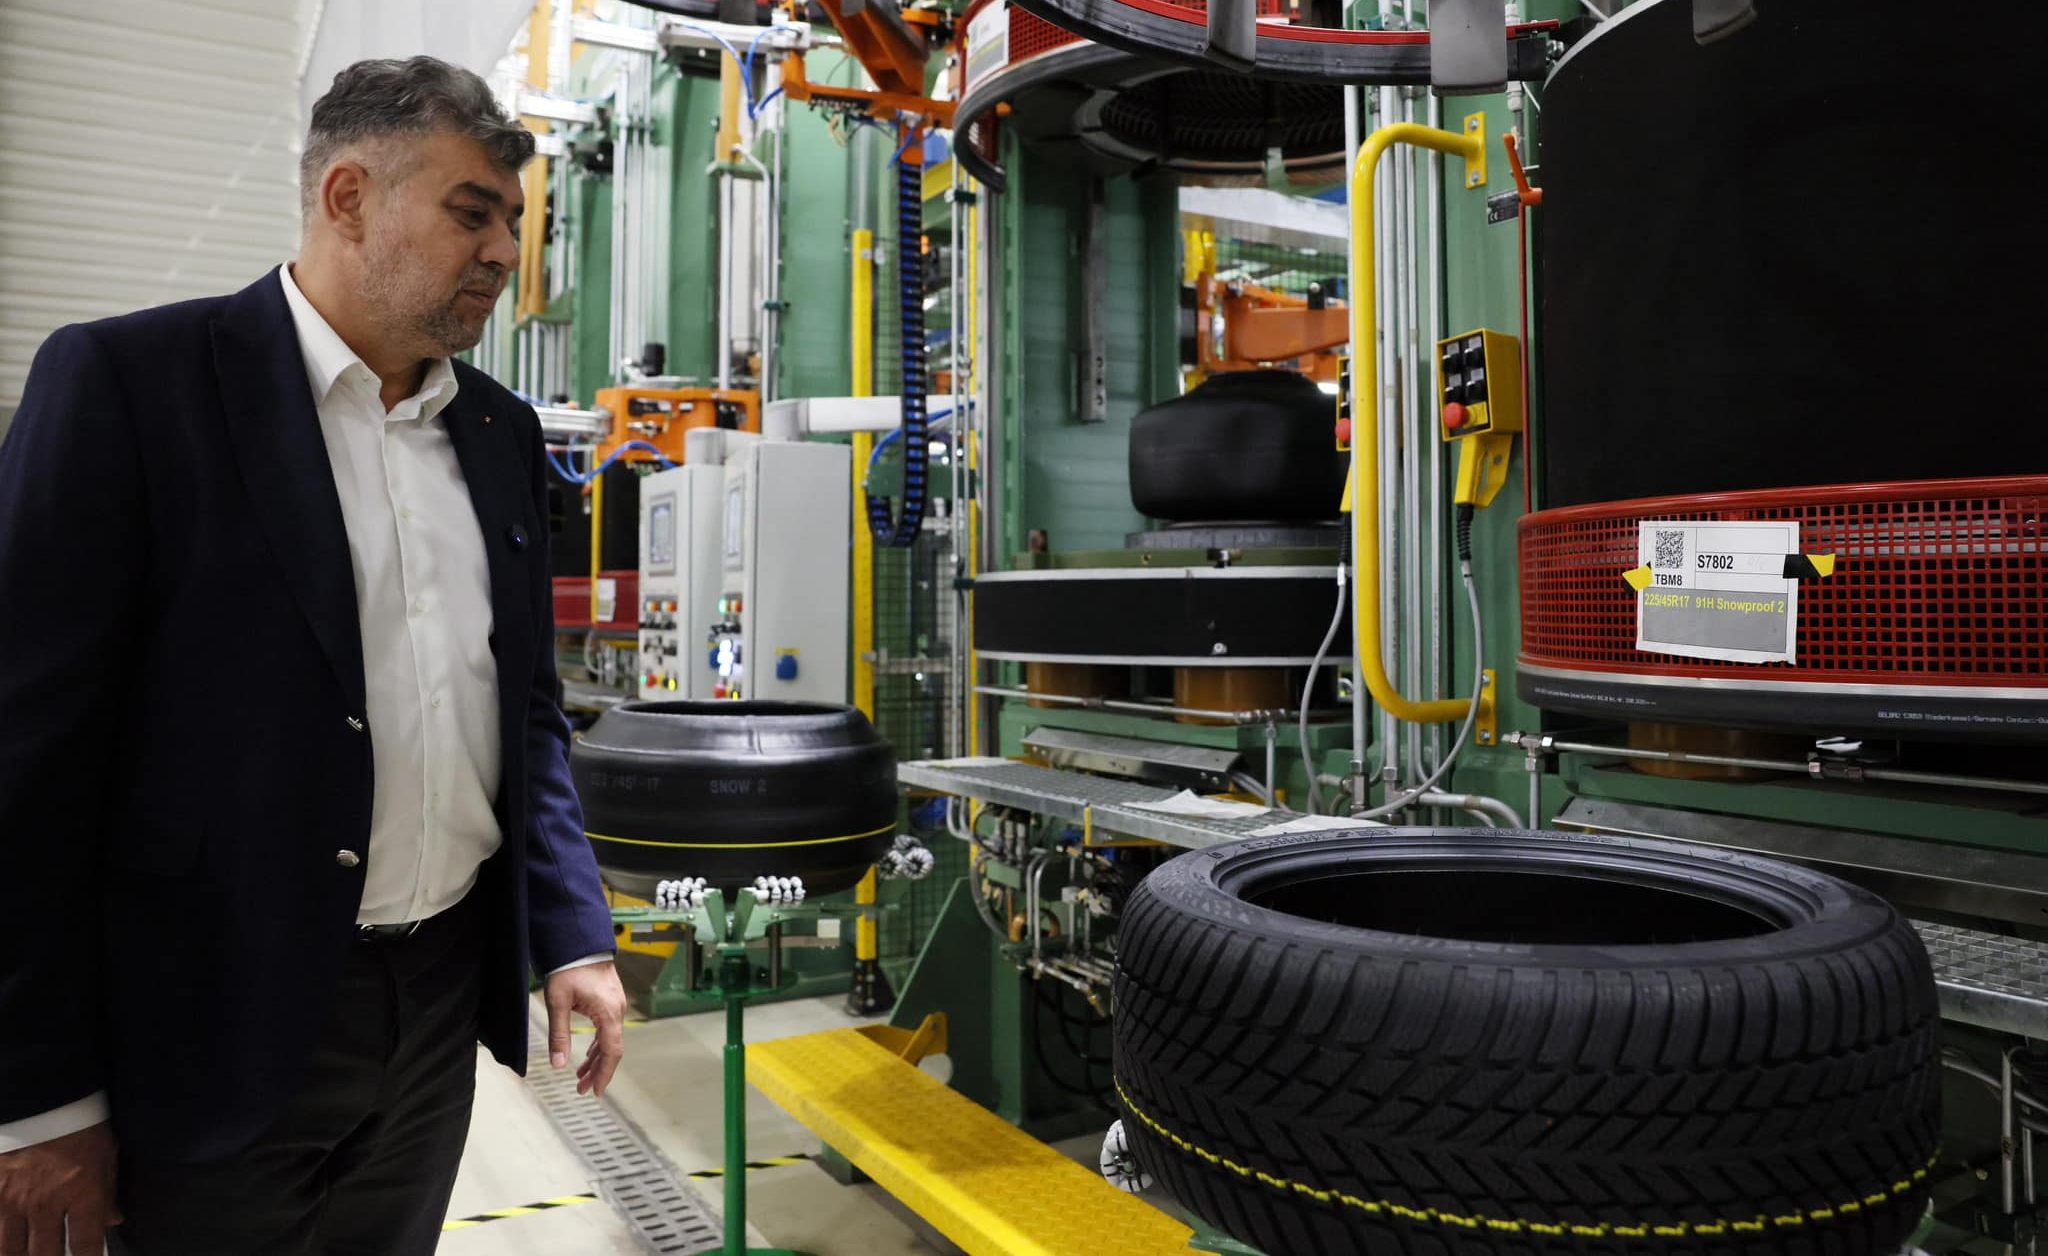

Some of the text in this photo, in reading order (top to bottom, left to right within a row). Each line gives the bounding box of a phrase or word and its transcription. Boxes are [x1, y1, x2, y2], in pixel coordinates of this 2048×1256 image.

[1697, 554, 1734, 570] S7802
[1654, 573, 1683, 586] TBM8
[1644, 592, 1785, 614] 225/45R17 91H Snowproof 2
[709, 779, 751, 792] SNOW
